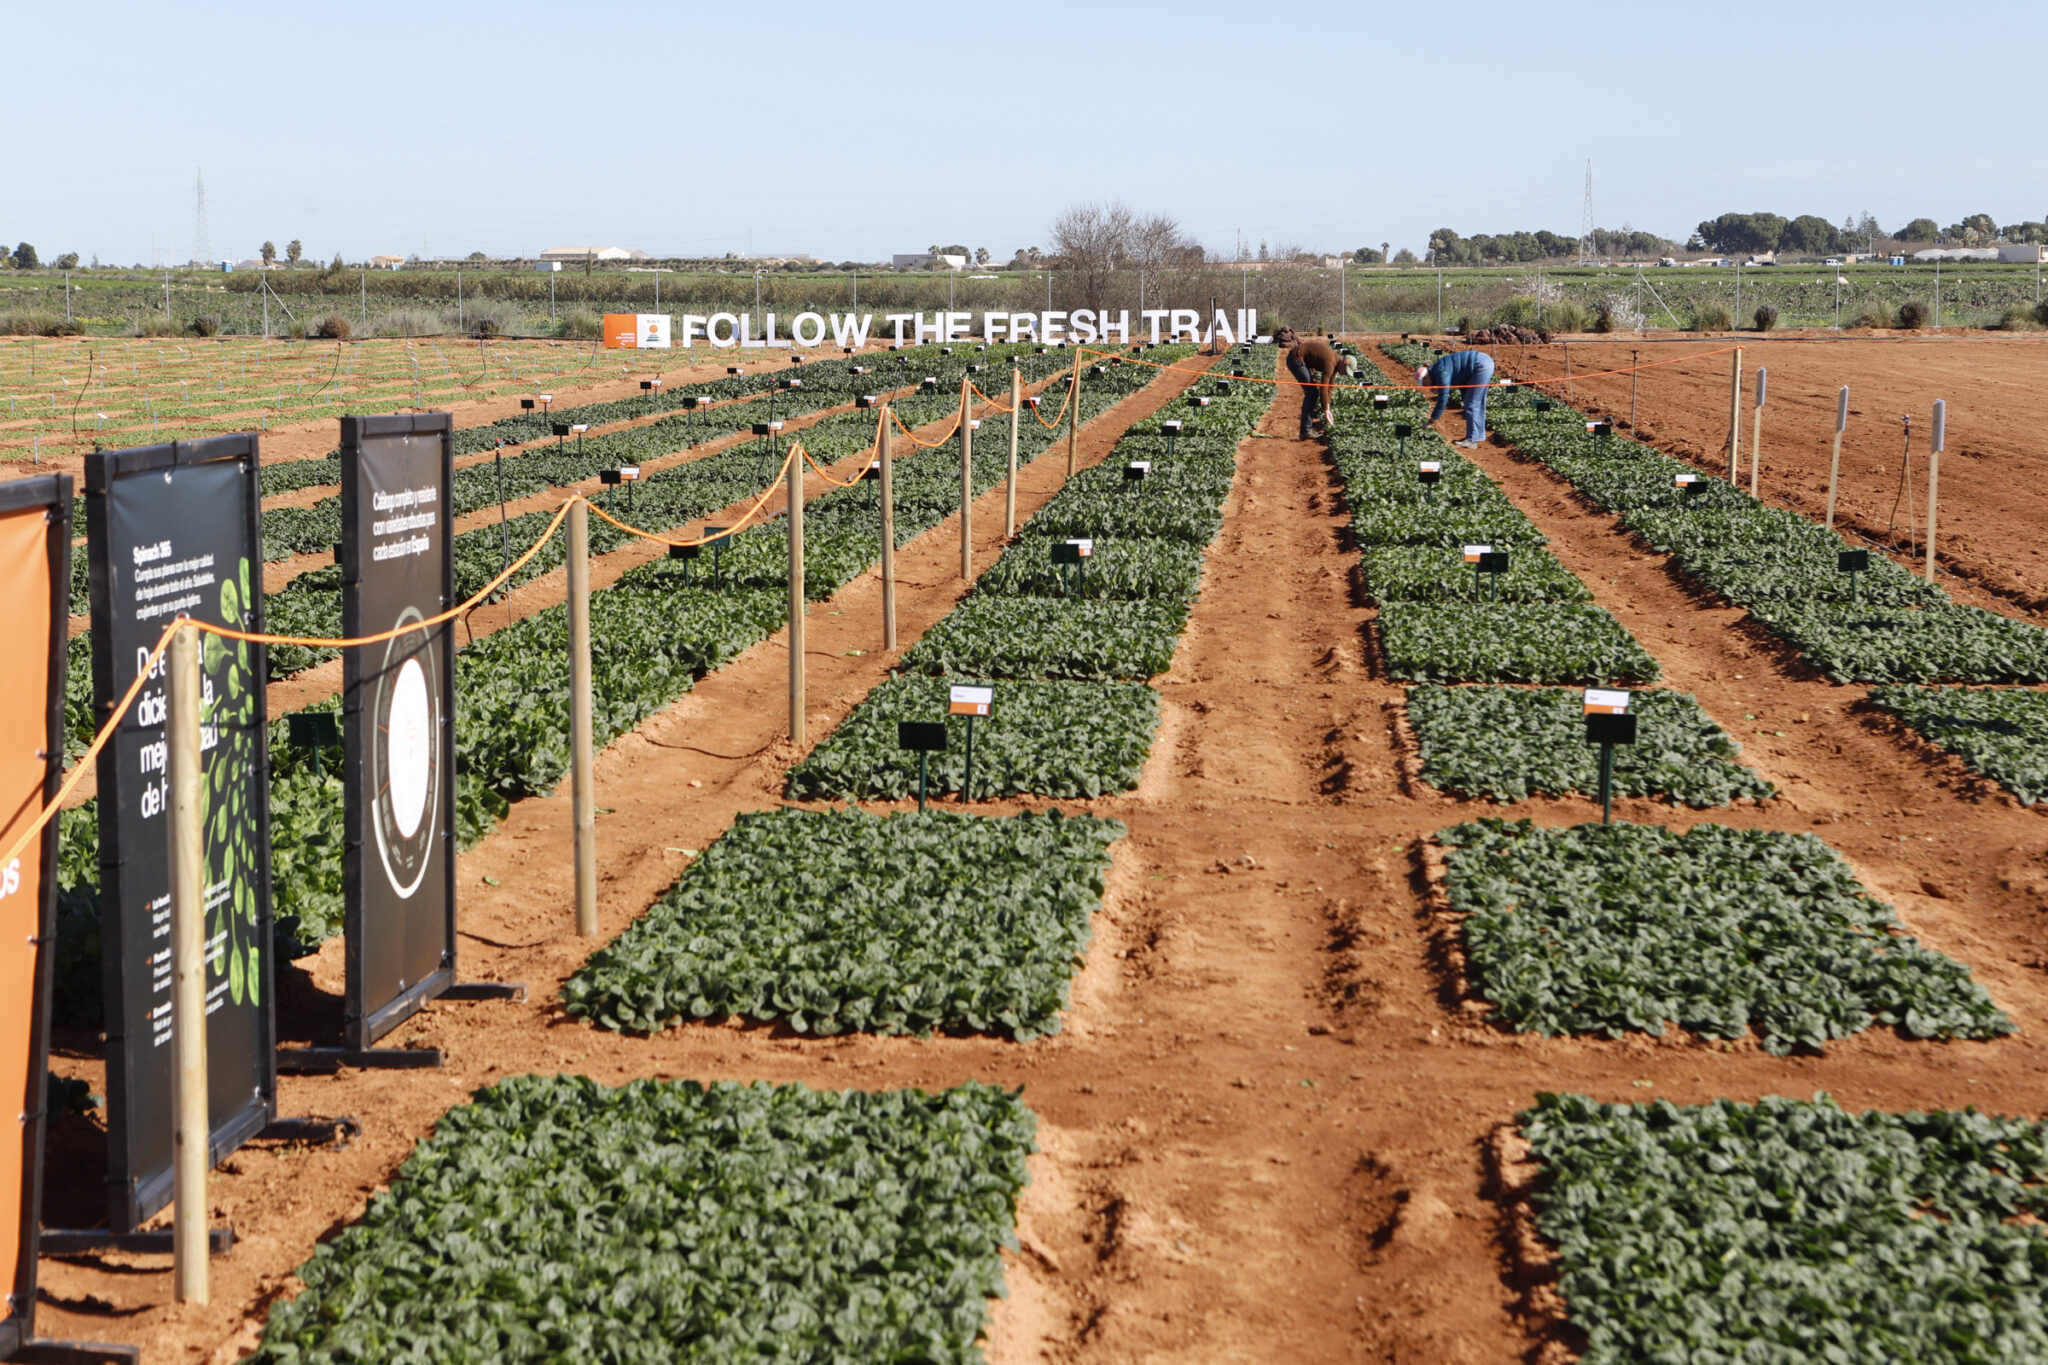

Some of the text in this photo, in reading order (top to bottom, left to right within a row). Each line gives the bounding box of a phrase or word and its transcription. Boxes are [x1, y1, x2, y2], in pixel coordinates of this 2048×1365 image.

[682, 309, 1273, 348] FOLLOW THE FRESH TRAIL
[373, 521, 385, 536] con
[133, 540, 172, 566] Spinach 365
[373, 541, 388, 562] cada
[412, 533, 429, 556] España
[203, 673, 214, 705] la
[141, 782, 160, 819] de
